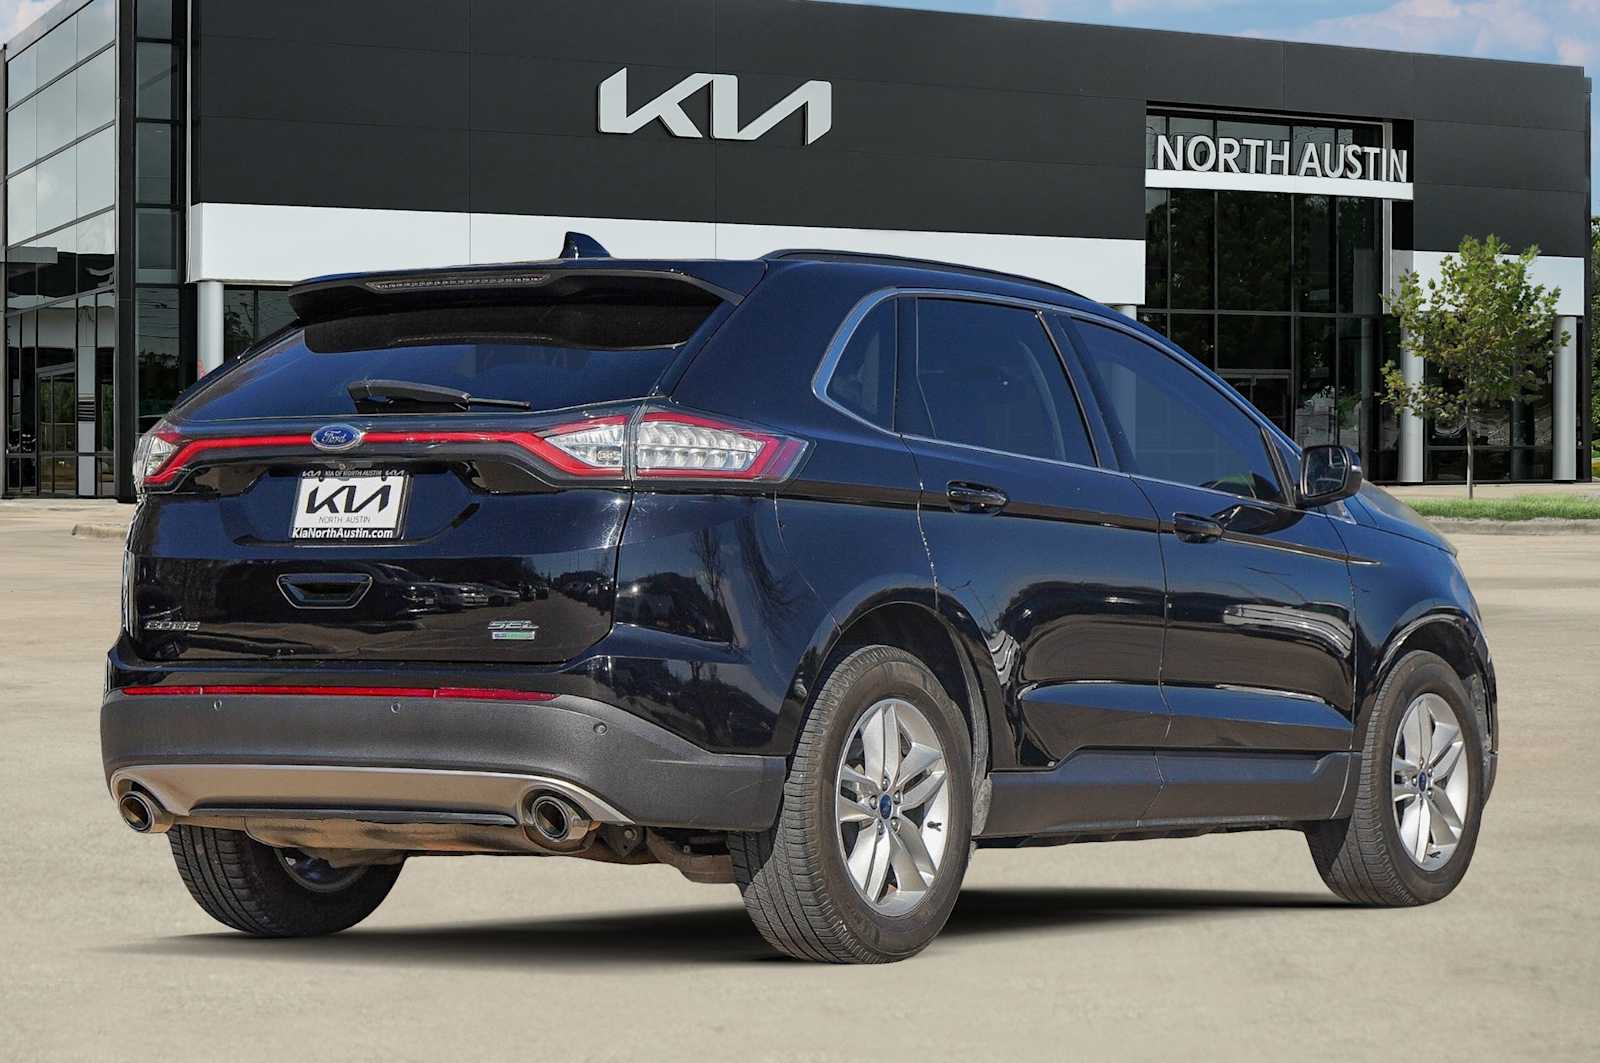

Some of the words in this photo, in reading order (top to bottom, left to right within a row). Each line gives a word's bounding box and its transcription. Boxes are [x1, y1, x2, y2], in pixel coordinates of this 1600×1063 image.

[599, 67, 832, 145] KIA
[1157, 135, 1290, 176] NORTH
[1298, 142, 1408, 183] AUSTIN
[321, 430, 348, 445] Ford
[362, 469, 382, 477] AUSTIN
[306, 485, 391, 514] KIA
[319, 516, 342, 524] NORTH
[346, 516, 371, 524] AUSTIN
[292, 527, 393, 539] KiaNorthAustin.com
